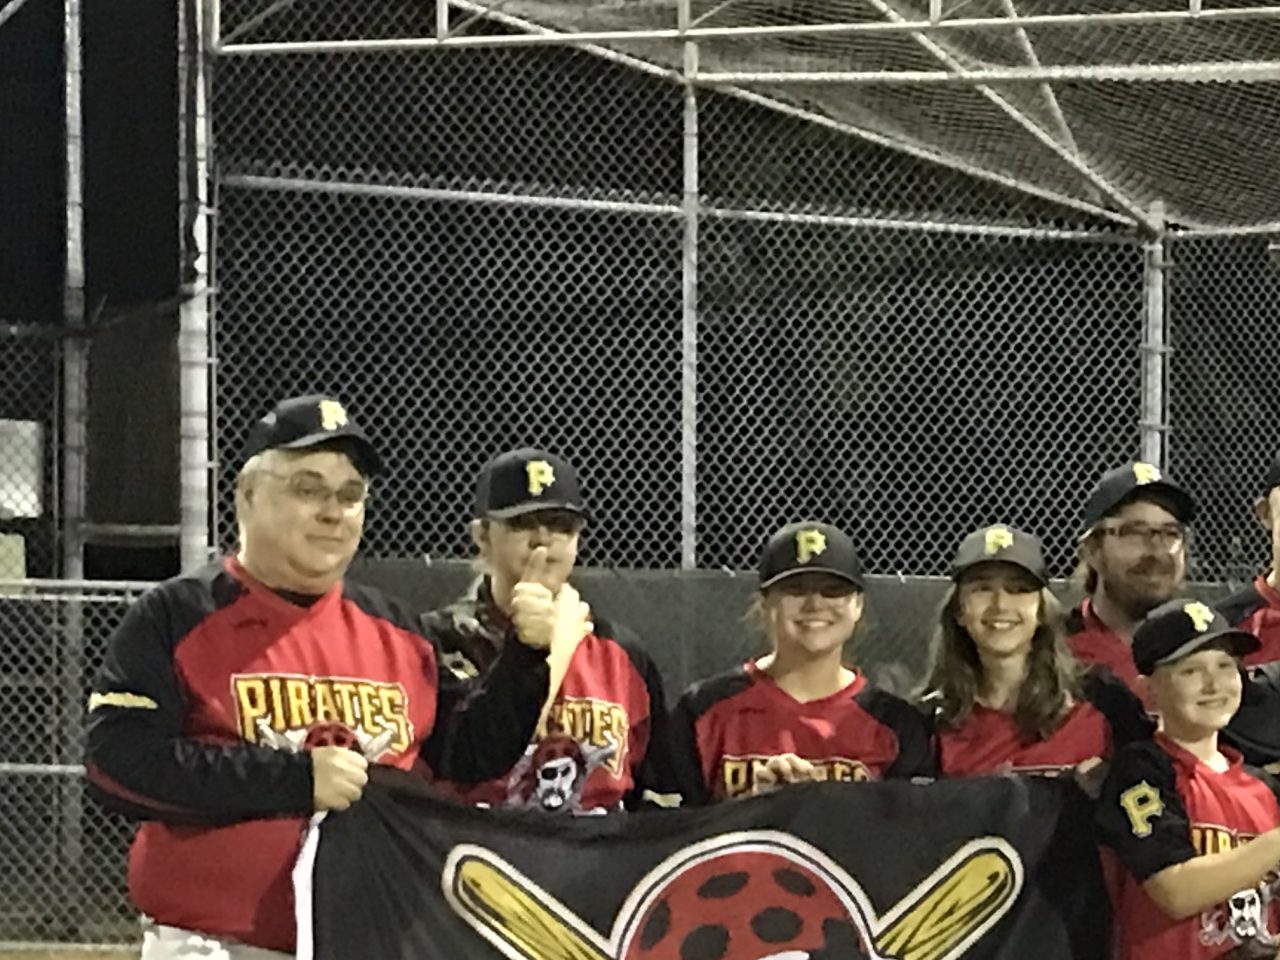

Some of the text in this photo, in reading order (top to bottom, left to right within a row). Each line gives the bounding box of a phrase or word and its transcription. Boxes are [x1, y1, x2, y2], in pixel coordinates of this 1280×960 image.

[319, 399, 350, 431] P
[525, 460, 555, 496] P
[796, 529, 826, 565] P
[984, 527, 1014, 557] P
[1184, 601, 1214, 632] P
[233, 673, 415, 757] PIRATES
[1120, 780, 1166, 839] P
